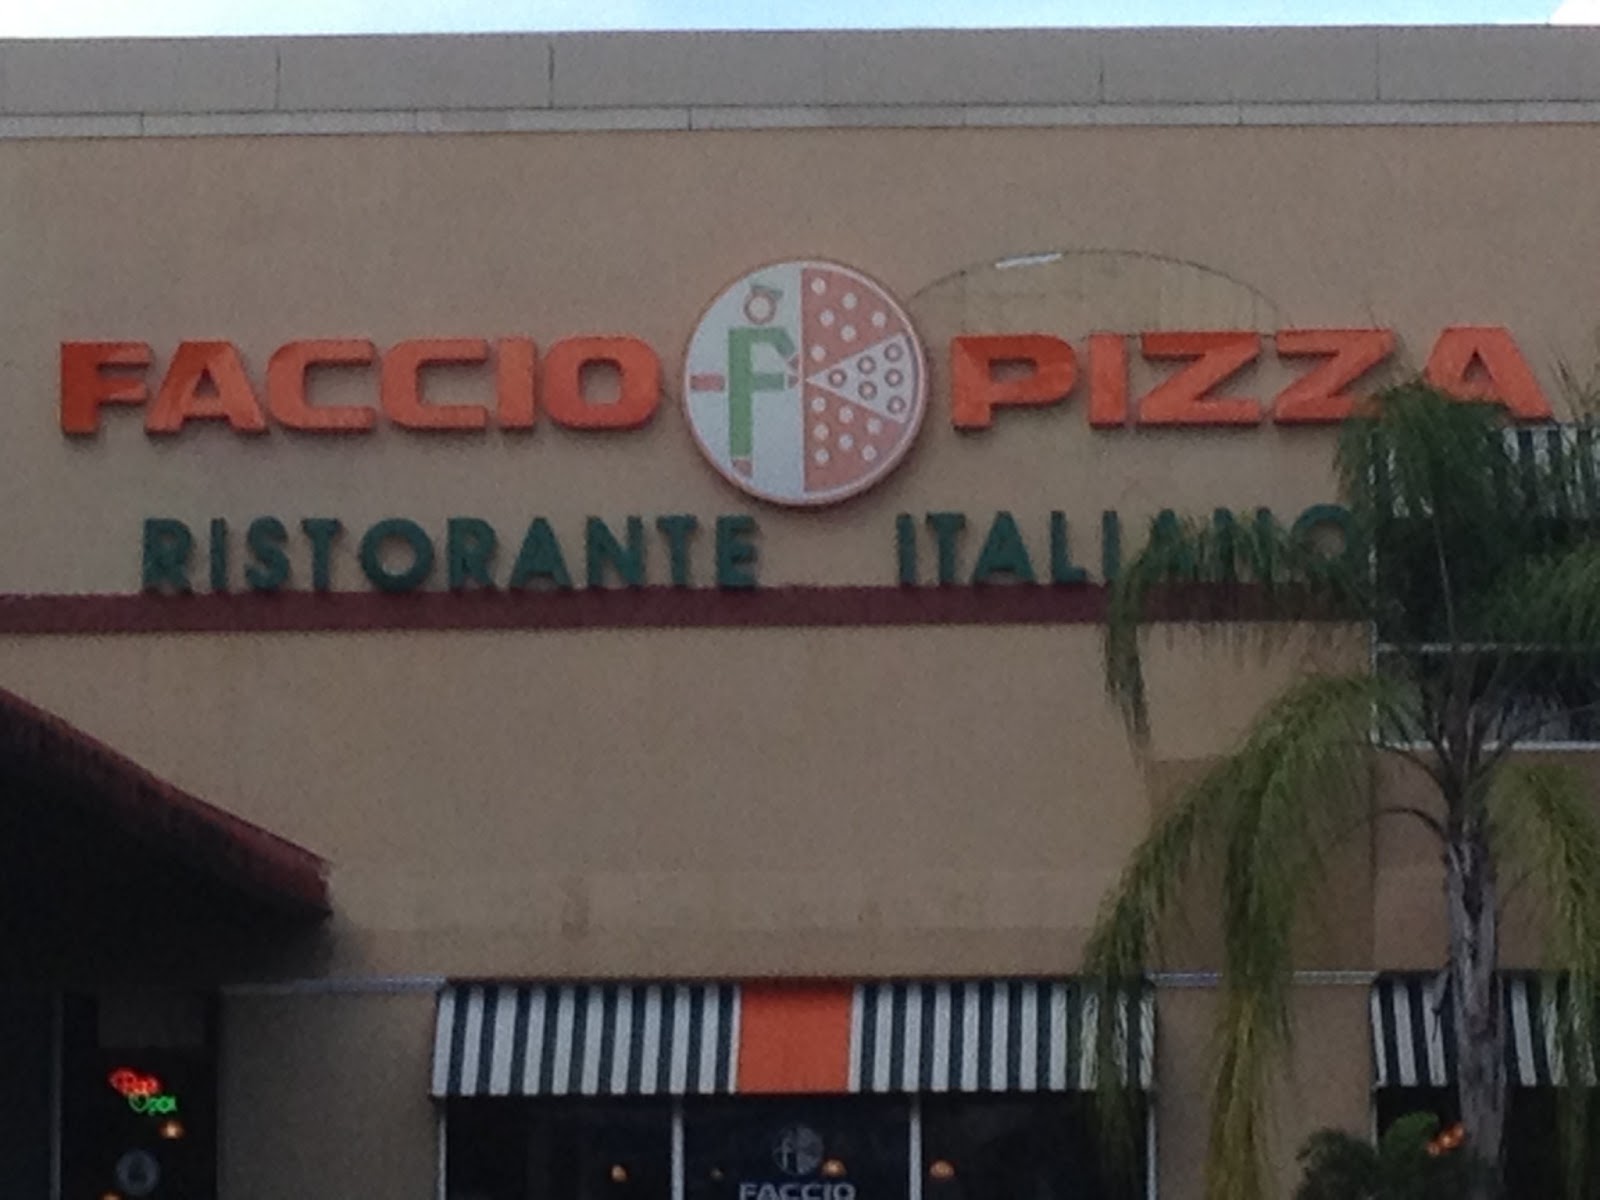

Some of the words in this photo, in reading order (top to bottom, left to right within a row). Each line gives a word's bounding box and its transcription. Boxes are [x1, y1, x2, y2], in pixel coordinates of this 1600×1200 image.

[59, 335, 662, 434] FACCIO
[950, 326, 1556, 430] PIZZA
[141, 512, 762, 593] RISTORANTE
[738, 1181, 857, 1200] FACCIO
